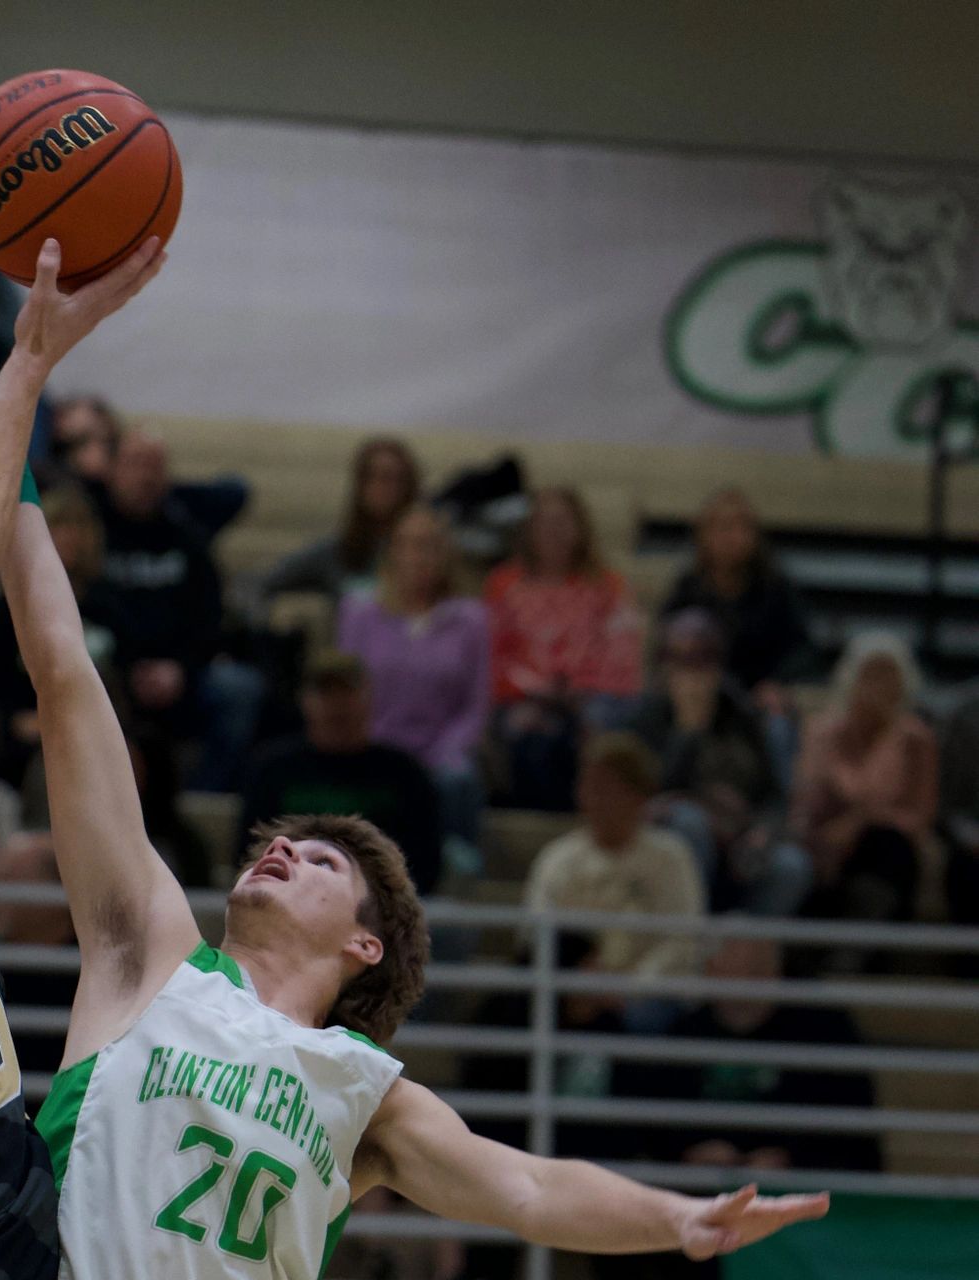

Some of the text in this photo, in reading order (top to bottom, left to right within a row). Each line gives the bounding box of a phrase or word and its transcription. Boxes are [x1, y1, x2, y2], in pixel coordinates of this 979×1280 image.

[137, 1045, 335, 1188] CLINTON CENTRAL
[152, 1121, 299, 1264] 20
